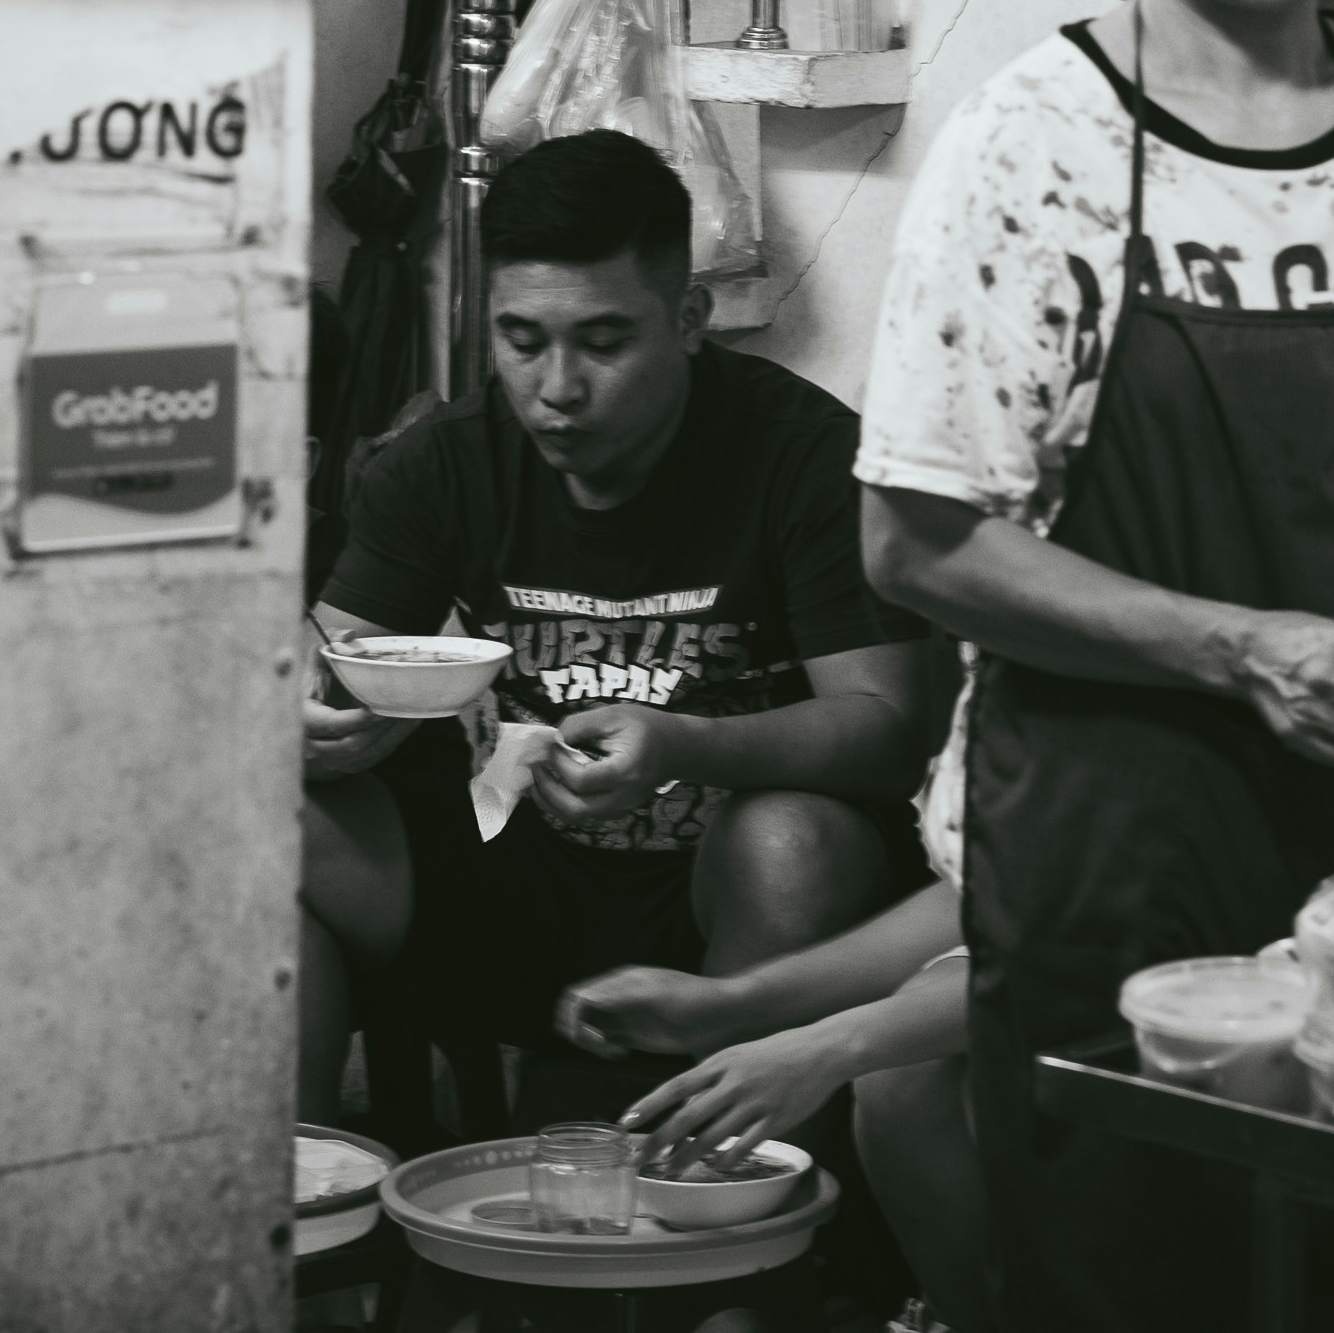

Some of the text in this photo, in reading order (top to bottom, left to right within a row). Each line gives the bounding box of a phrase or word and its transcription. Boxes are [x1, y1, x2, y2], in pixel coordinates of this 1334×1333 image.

[51, 380, 220, 430] GrabFood
[503, 585, 719, 619] TEENAGE MUTANT NINJA
